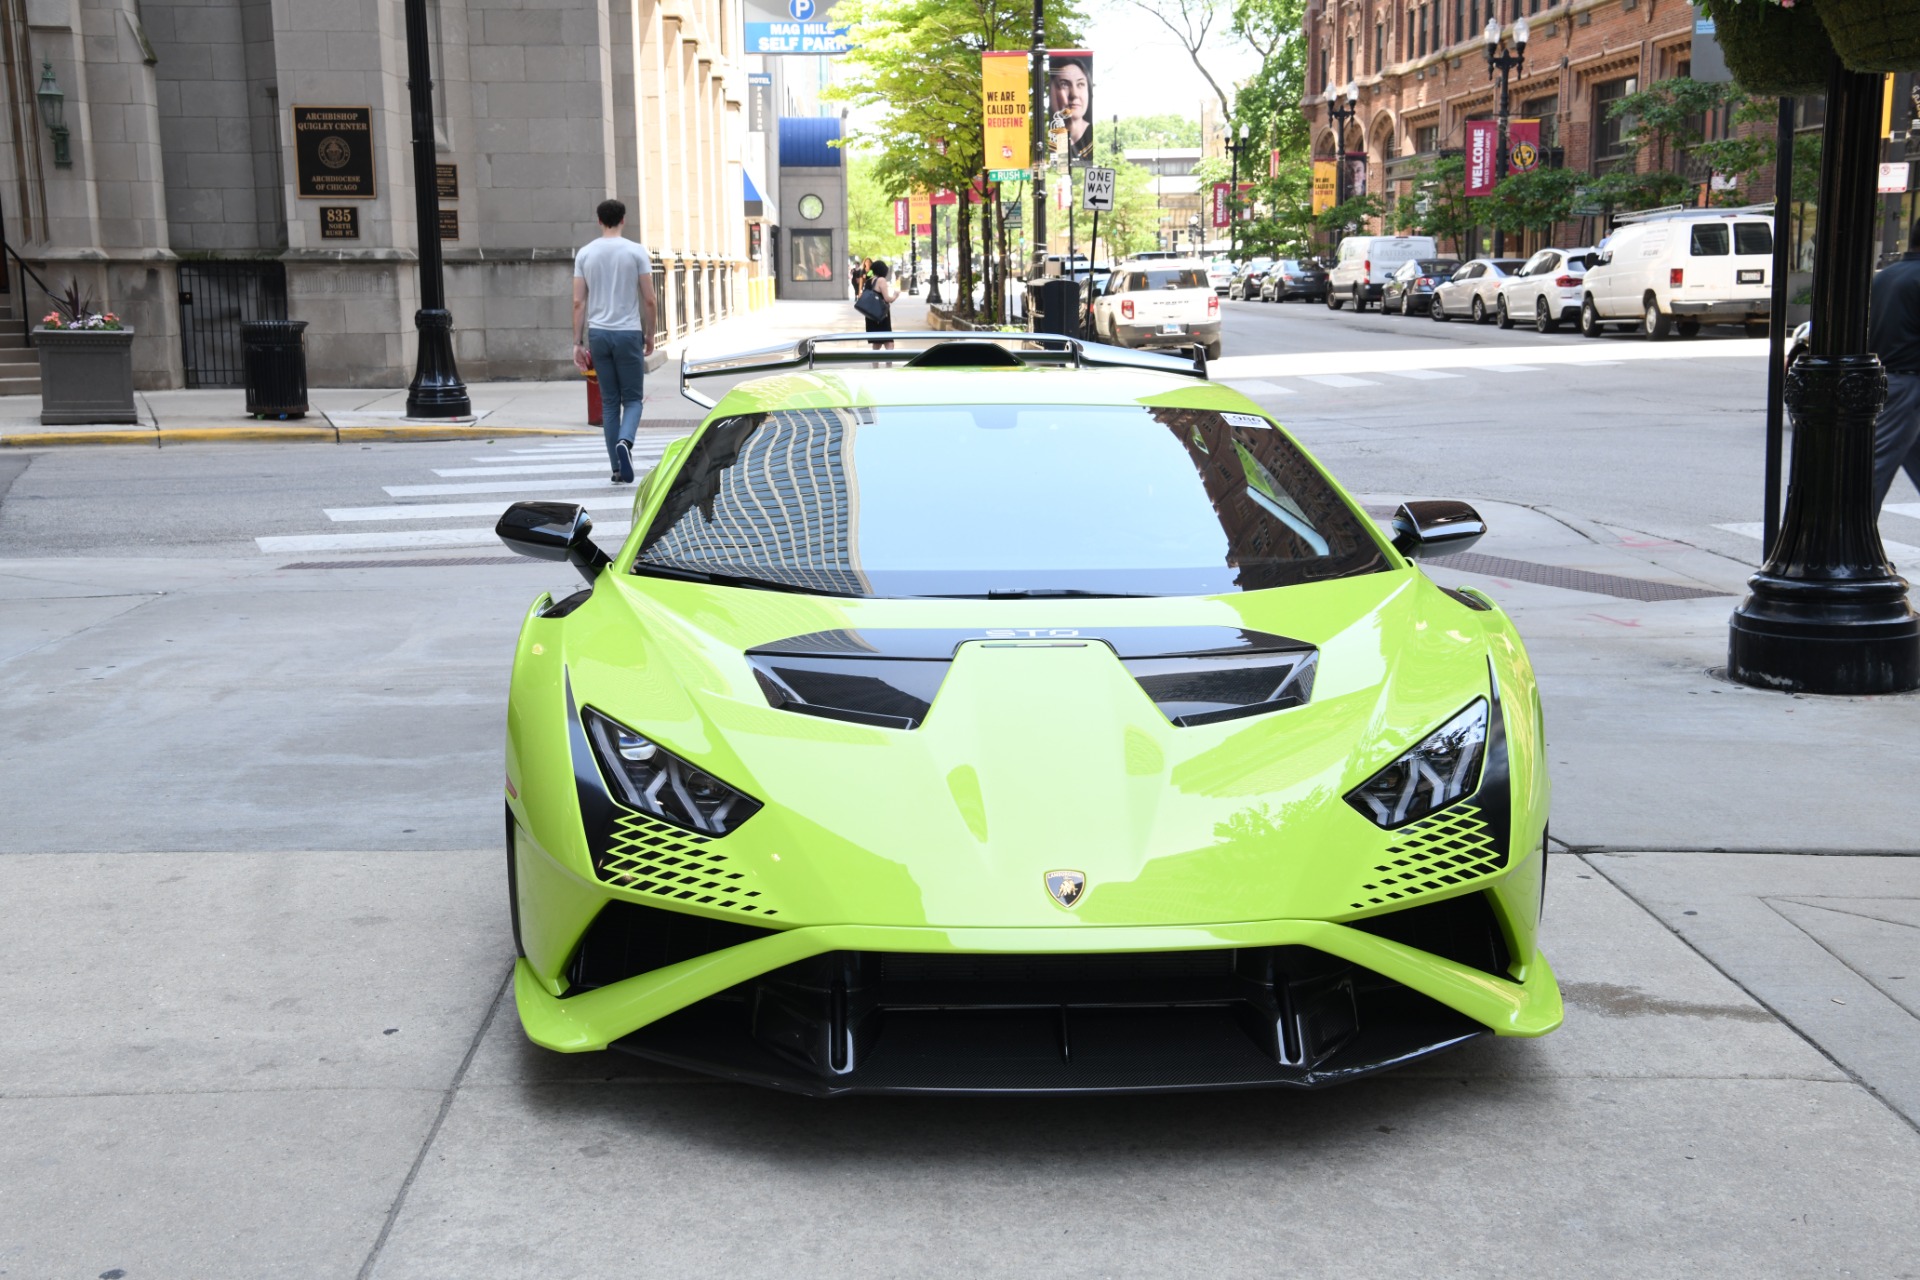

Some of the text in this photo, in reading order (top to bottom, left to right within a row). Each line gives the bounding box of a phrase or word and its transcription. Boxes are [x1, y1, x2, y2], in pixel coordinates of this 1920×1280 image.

[770, 23, 800, 35] MAG
[758, 37, 799, 51] SELF
[987, 91, 1015, 101] WE ARE
[987, 104, 1026, 115] CALLED TO
[305, 112, 359, 120] ARCHBISHOP
[297, 122, 368, 131] QUIGLEY CENTER
[987, 117, 1023, 128] REDEFINE
[1471, 129, 1485, 189] WELCOME
[997, 170, 1021, 180] RUSH
[1088, 171, 1112, 182] ONE
[1087, 183, 1111, 194] WAY
[1216, 188, 1224, 224] WELCOME
[327, 208, 352, 222] 835
